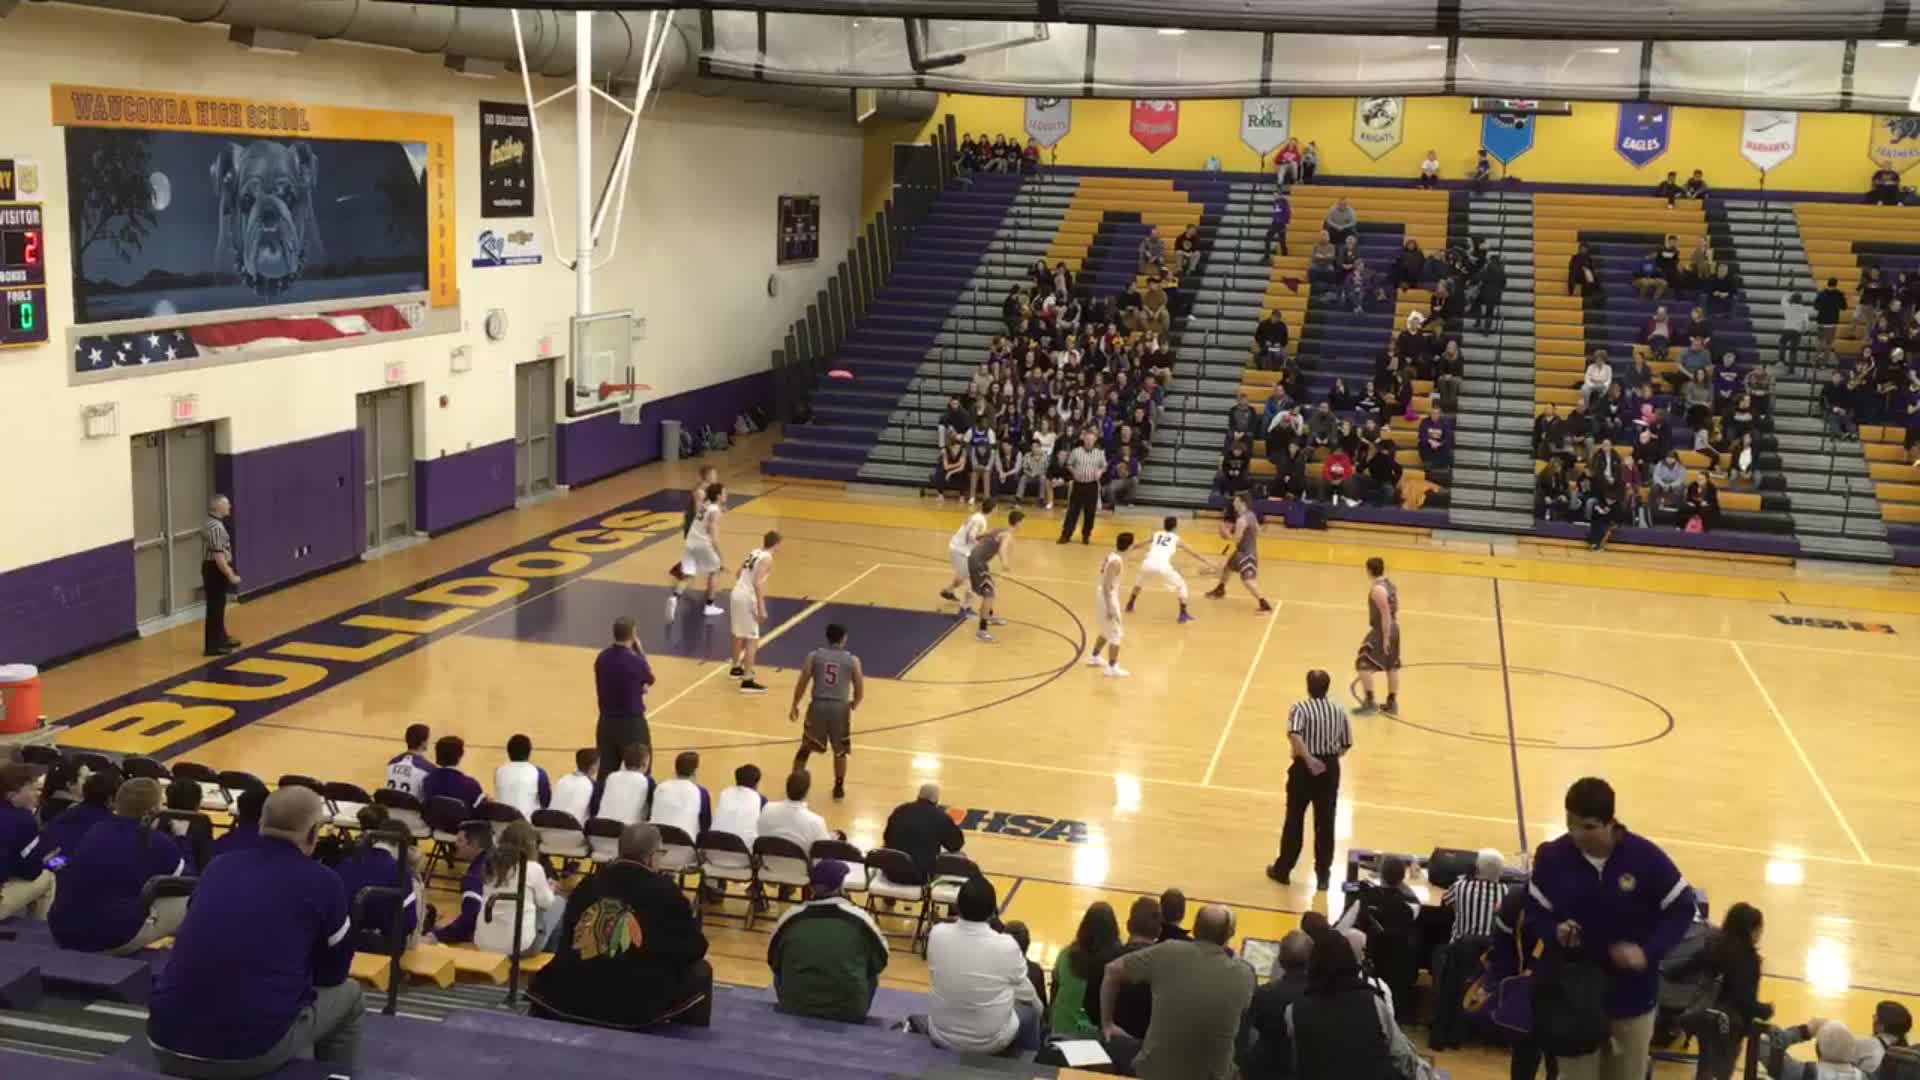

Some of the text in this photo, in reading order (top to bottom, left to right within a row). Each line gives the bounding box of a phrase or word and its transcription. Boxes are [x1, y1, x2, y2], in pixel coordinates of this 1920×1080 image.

[72, 91, 310, 132] WAUCONDA HIGH SCHOOL
[1621, 136, 1661, 152] EAGLES
[24, 231, 38, 264] 2
[20, 302, 33, 330] 0
[1156, 533, 1172, 547] 12
[54, 509, 687, 755] BULLDOGS
[823, 662, 840, 688] 5
[938, 804, 1089, 844] HSA
